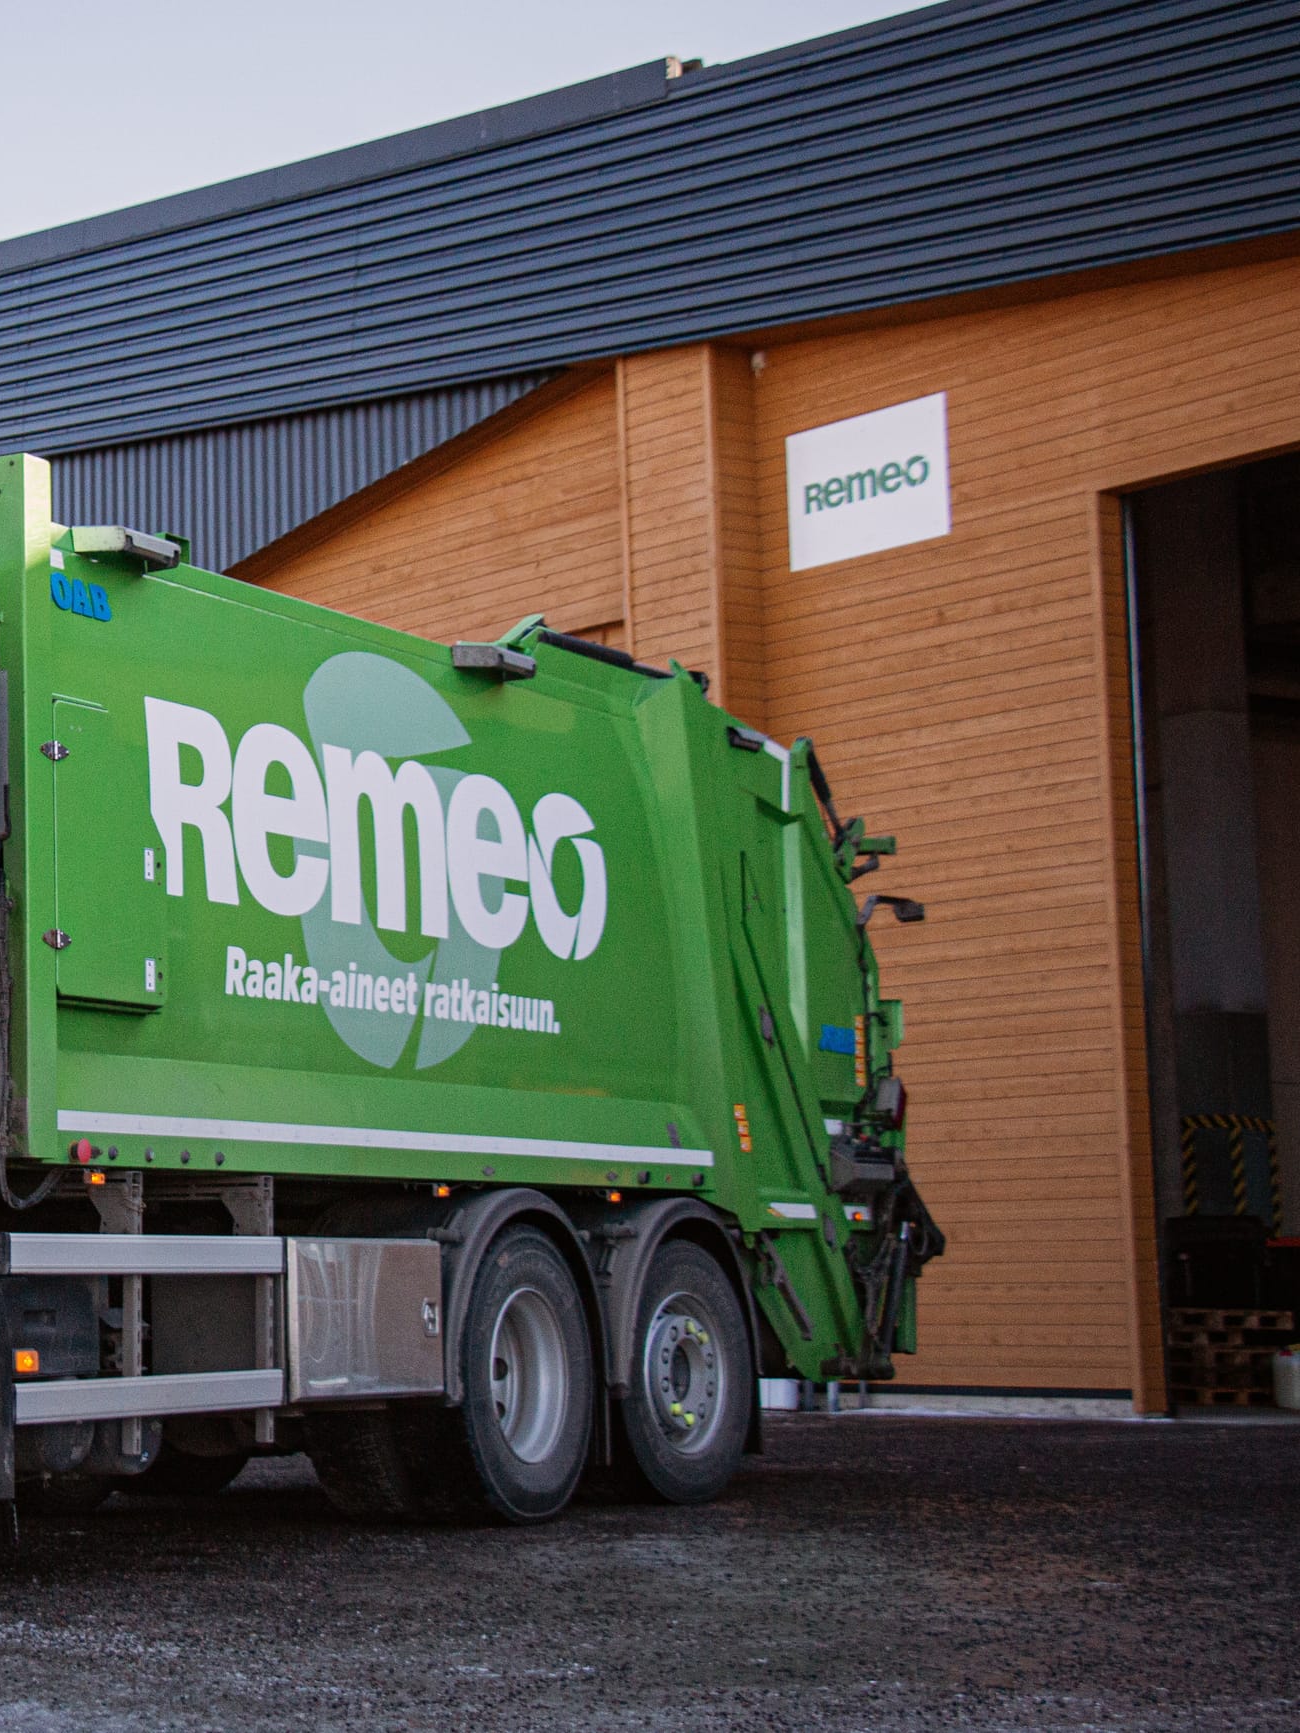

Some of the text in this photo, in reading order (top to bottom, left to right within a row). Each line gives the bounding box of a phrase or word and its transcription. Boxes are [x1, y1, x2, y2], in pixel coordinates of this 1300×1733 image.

[804, 455, 930, 515] Remeo
[50, 572, 112, 622] OAB
[144, 696, 607, 961] Remeo
[225, 946, 561, 1034] Raaka-aineet ratkaisuun.
